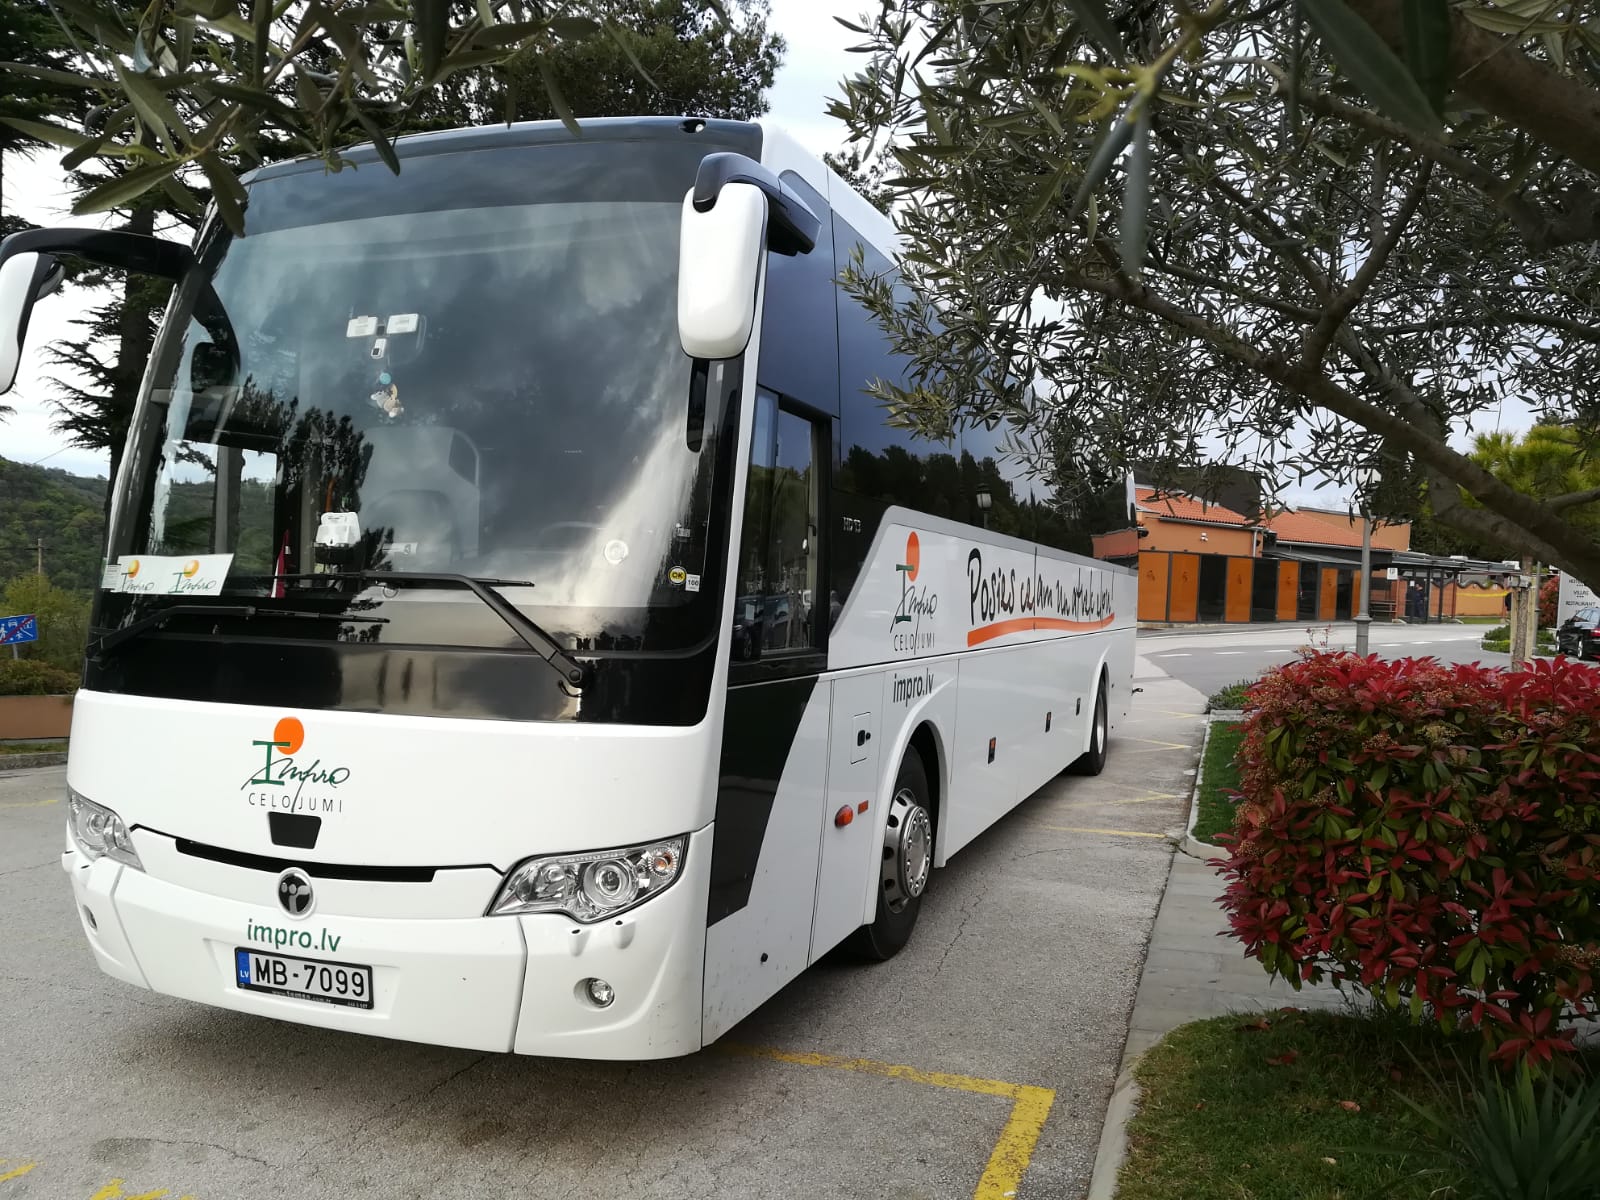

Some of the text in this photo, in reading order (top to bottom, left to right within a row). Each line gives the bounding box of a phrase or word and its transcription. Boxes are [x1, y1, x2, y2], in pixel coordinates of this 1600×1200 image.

[890, 564, 938, 655] Impro
[893, 667, 934, 708] impro.lv
[240, 740, 351, 813] Impro
[247, 918, 341, 952] impro.lv
[240, 969, 249, 978] LV
[255, 957, 364, 997] MB-7099
